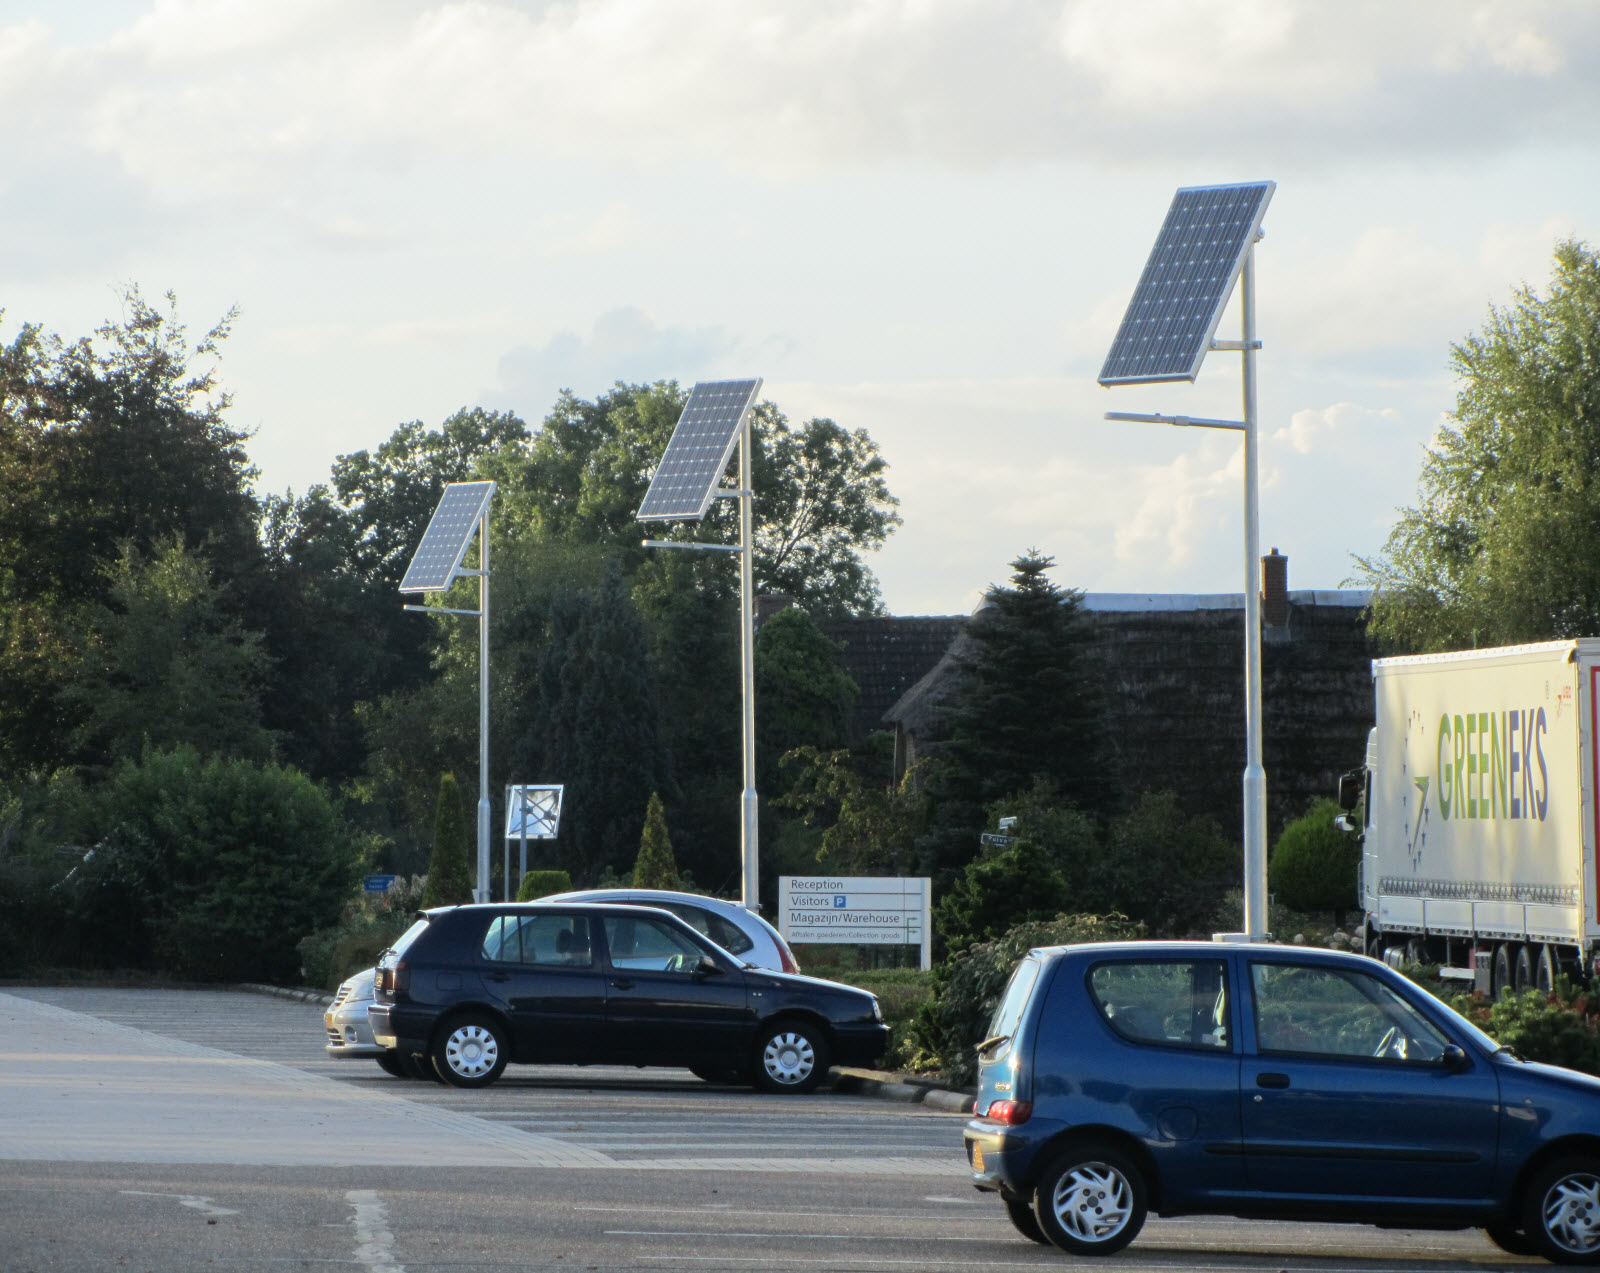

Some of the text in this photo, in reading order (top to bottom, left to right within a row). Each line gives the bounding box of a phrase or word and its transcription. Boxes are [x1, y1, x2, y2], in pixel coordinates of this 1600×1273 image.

[1437, 706, 1549, 822] GREENEKS
[791, 879, 843, 891] Reception
[791, 896, 829, 906] Visitors
[791, 913, 900, 925] Magazijn/Warehouse
[817, 931, 879, 940] goederen/Collection
[881, 932, 900, 940] goods
